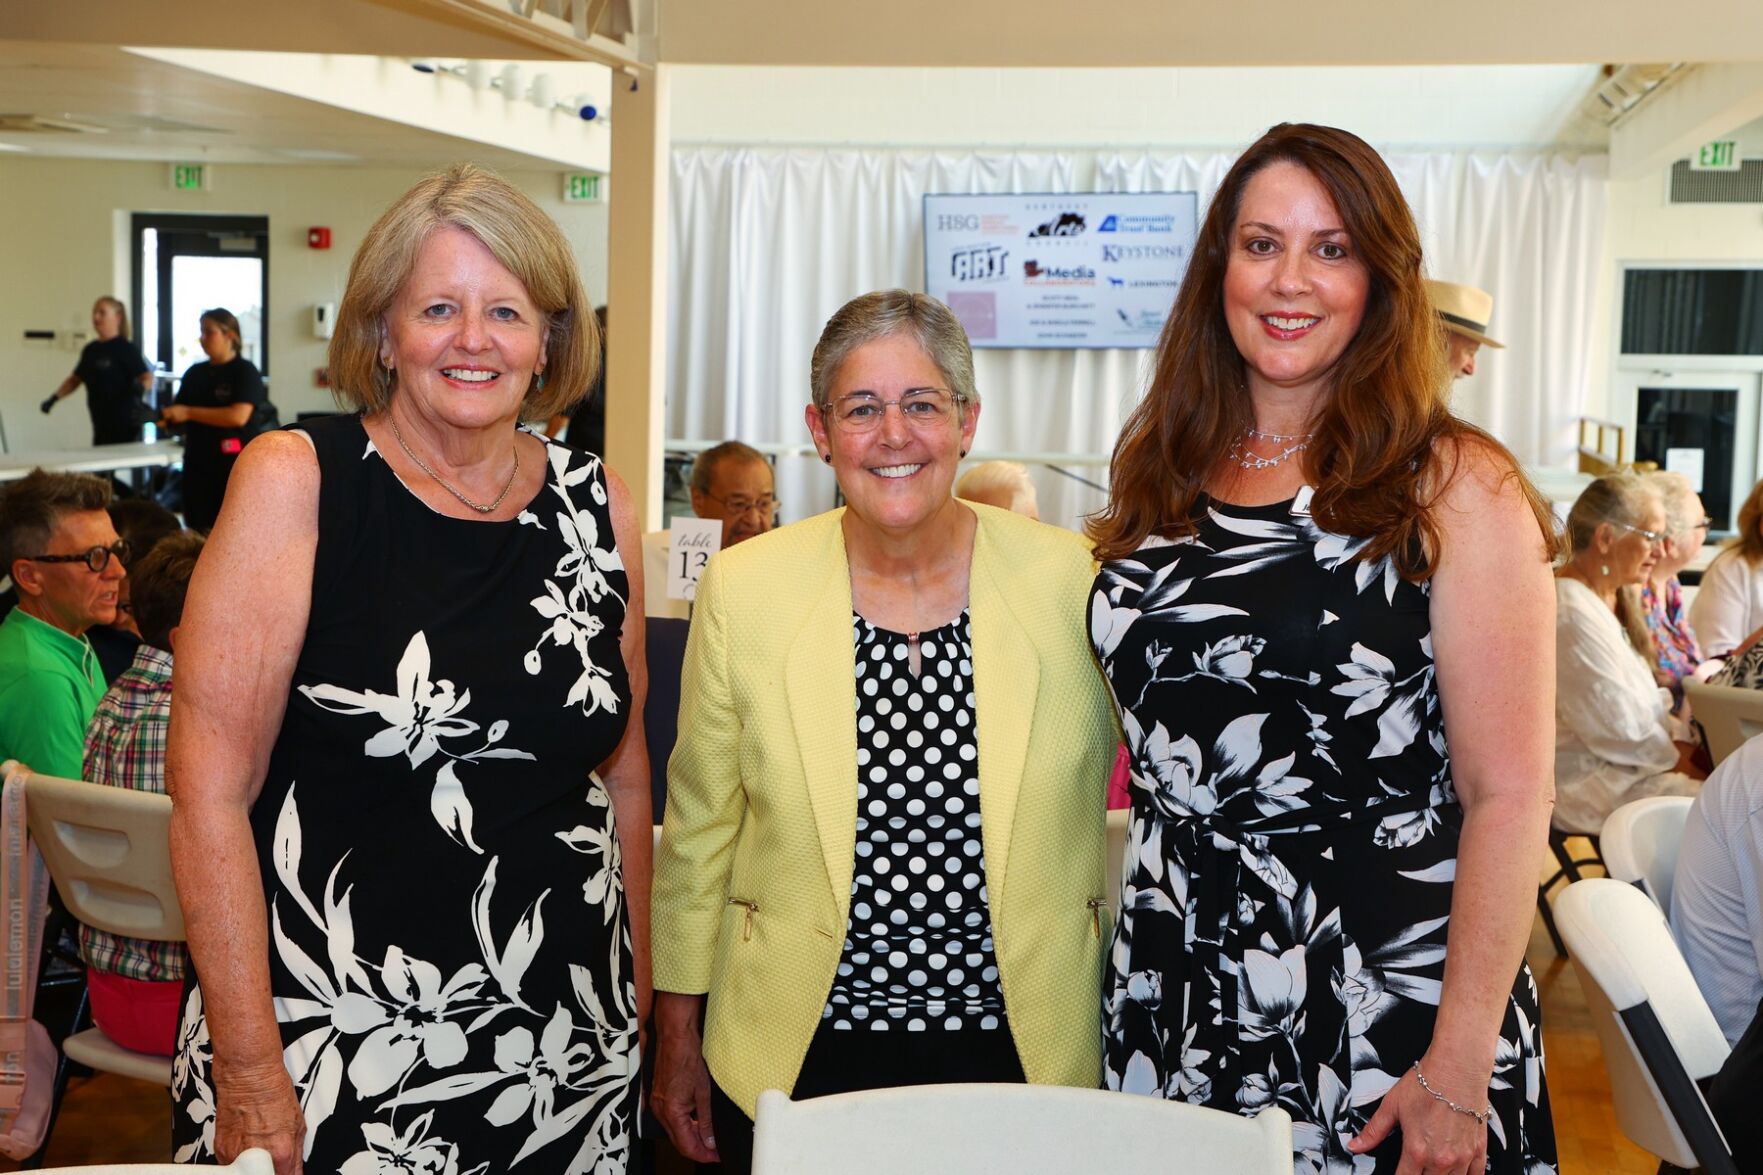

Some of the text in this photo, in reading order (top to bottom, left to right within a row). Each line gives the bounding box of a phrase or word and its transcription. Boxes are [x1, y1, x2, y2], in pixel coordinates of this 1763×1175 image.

[1700, 142, 1735, 166] EXIT
[175, 165, 203, 189] EXIT
[571, 175, 599, 199] EXIT
[938, 213, 979, 231] HSG
[1046, 265, 1096, 278] Media
[678, 532, 711, 548] table
[4, 898, 23, 989] lululemon
